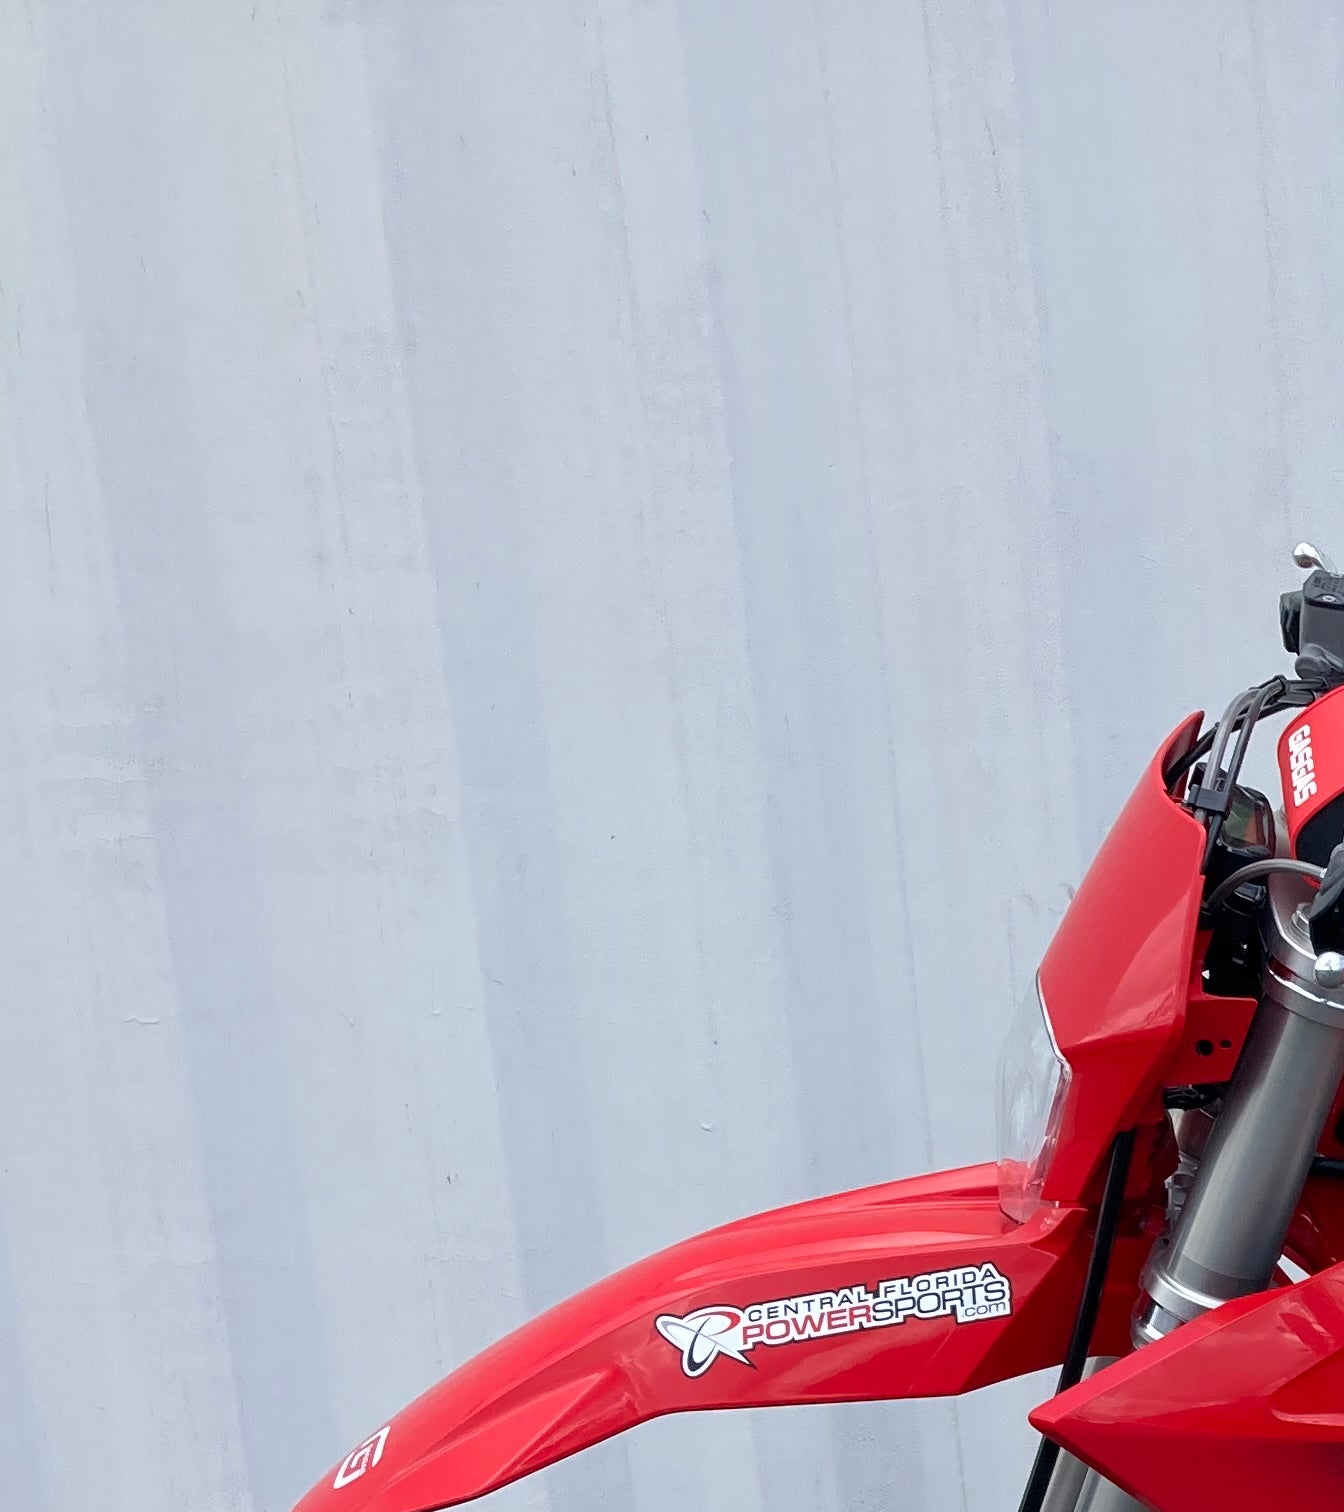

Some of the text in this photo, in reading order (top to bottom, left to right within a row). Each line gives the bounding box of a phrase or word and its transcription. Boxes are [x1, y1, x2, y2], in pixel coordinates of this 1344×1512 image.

[1288, 724, 1318, 808] GASGAS
[742, 1280, 1006, 1346] POWERSPORTS
[748, 1268, 996, 1322] CENTRAL FLORIDA
[962, 1301, 1006, 1319] .com
